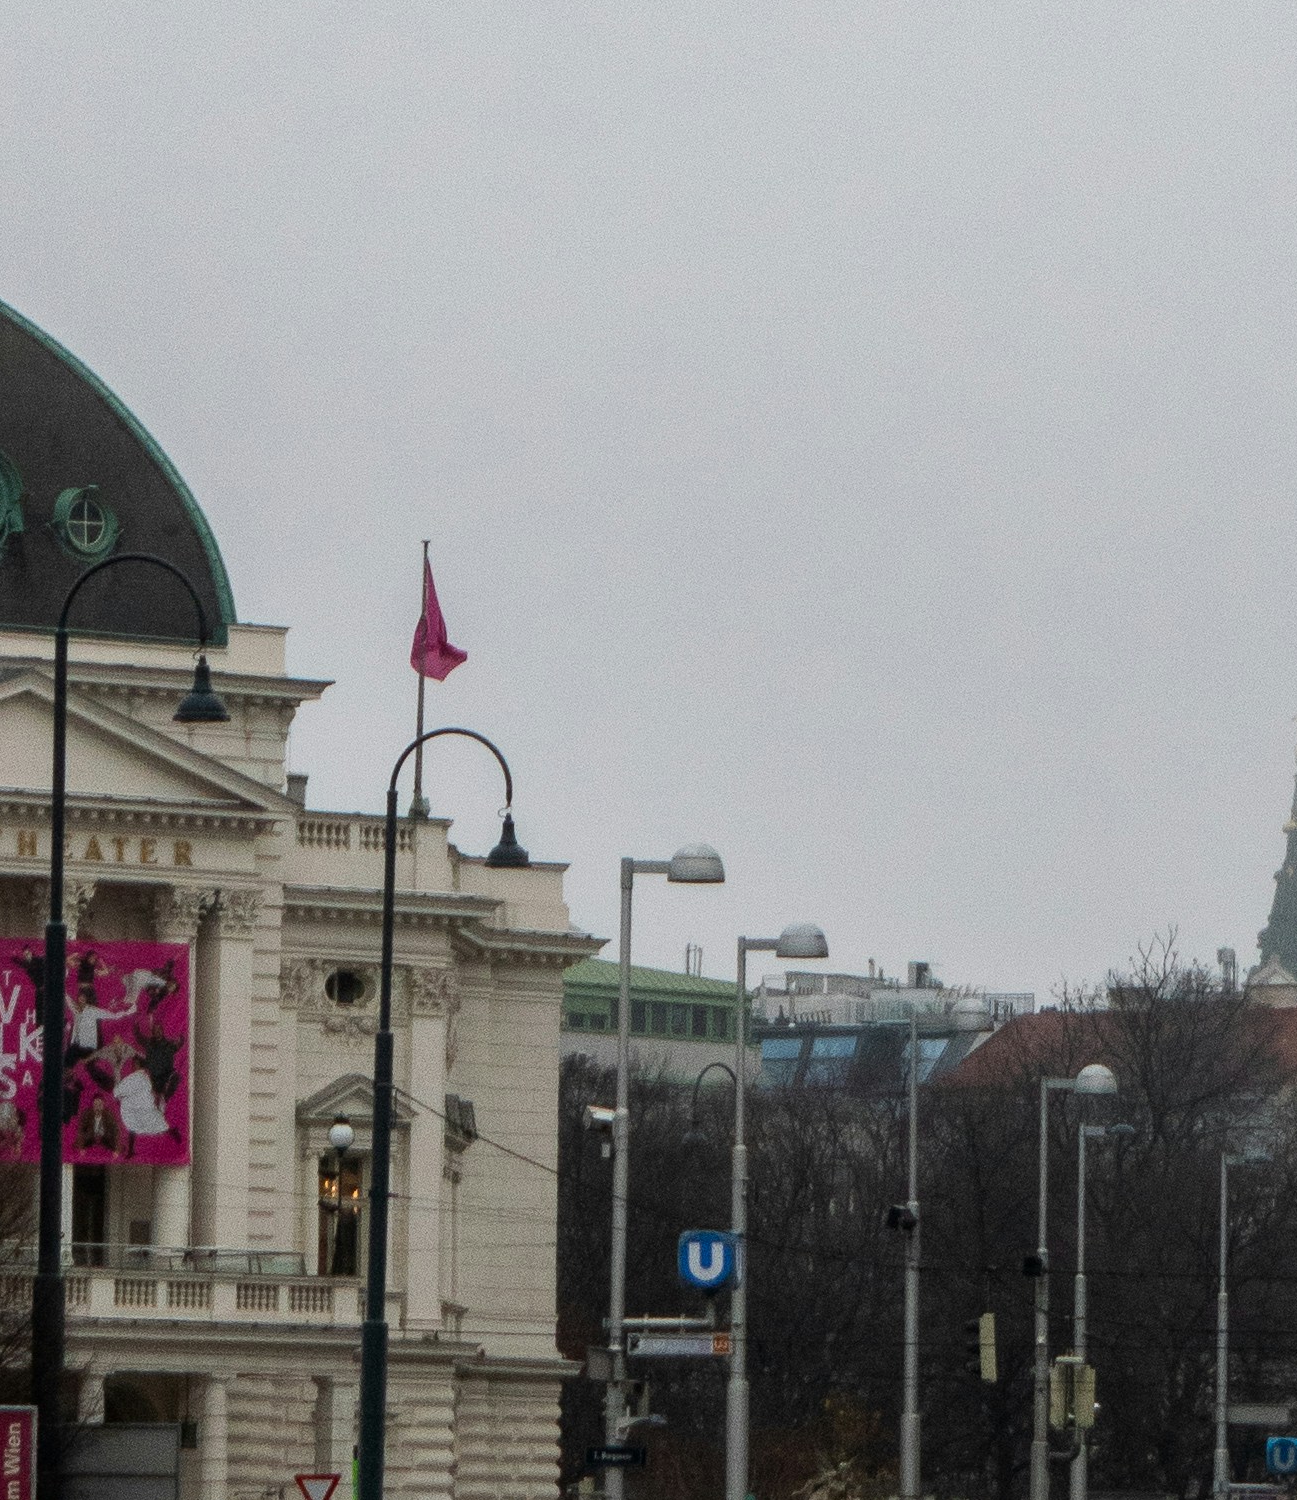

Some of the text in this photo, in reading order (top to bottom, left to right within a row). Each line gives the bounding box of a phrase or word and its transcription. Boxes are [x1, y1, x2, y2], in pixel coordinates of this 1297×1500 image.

[687, 1241, 725, 1282] U
[3, 1422, 21, 1475] Wien
[1272, 1445, 1296, 1472] U
